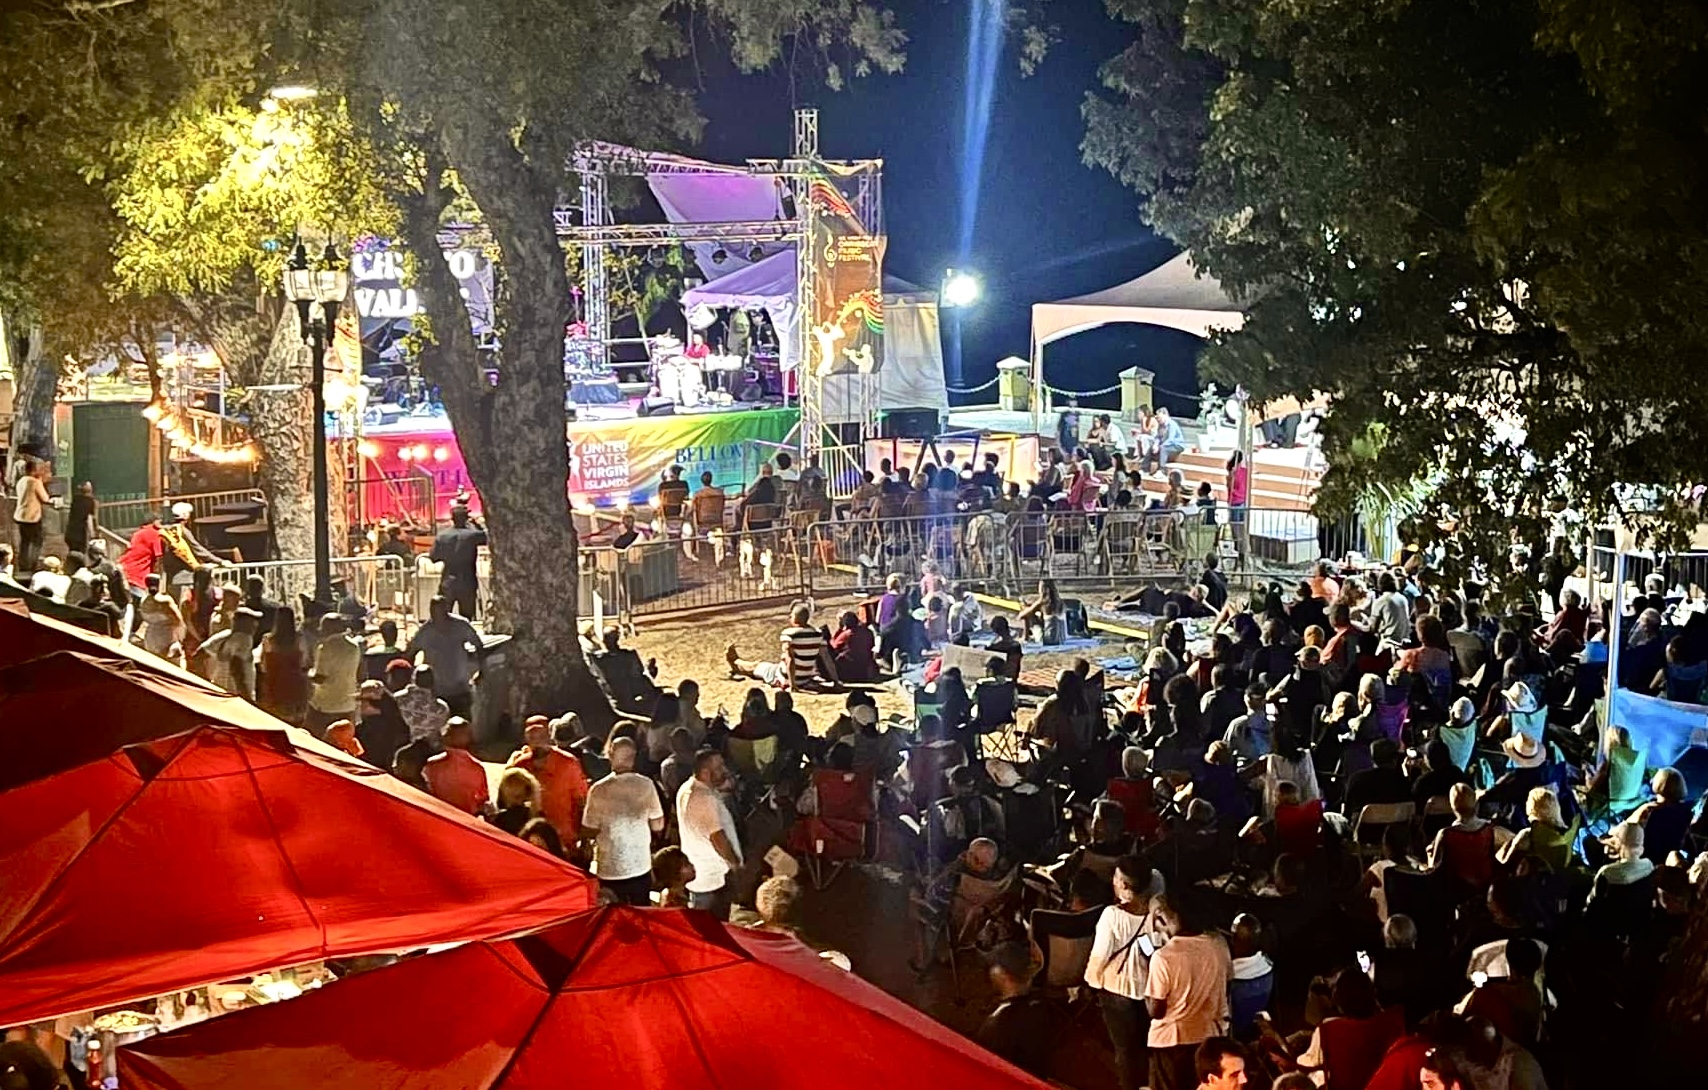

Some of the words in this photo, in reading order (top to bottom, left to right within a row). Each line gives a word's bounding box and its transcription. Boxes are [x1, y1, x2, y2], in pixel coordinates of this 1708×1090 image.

[838, 254, 872, 262] FESTIVAL
[582, 440, 629, 454] UNITED
[582, 453, 628, 467] STATES
[583, 465, 630, 480] VIRGIN
[583, 478, 630, 490] ISLANDS
